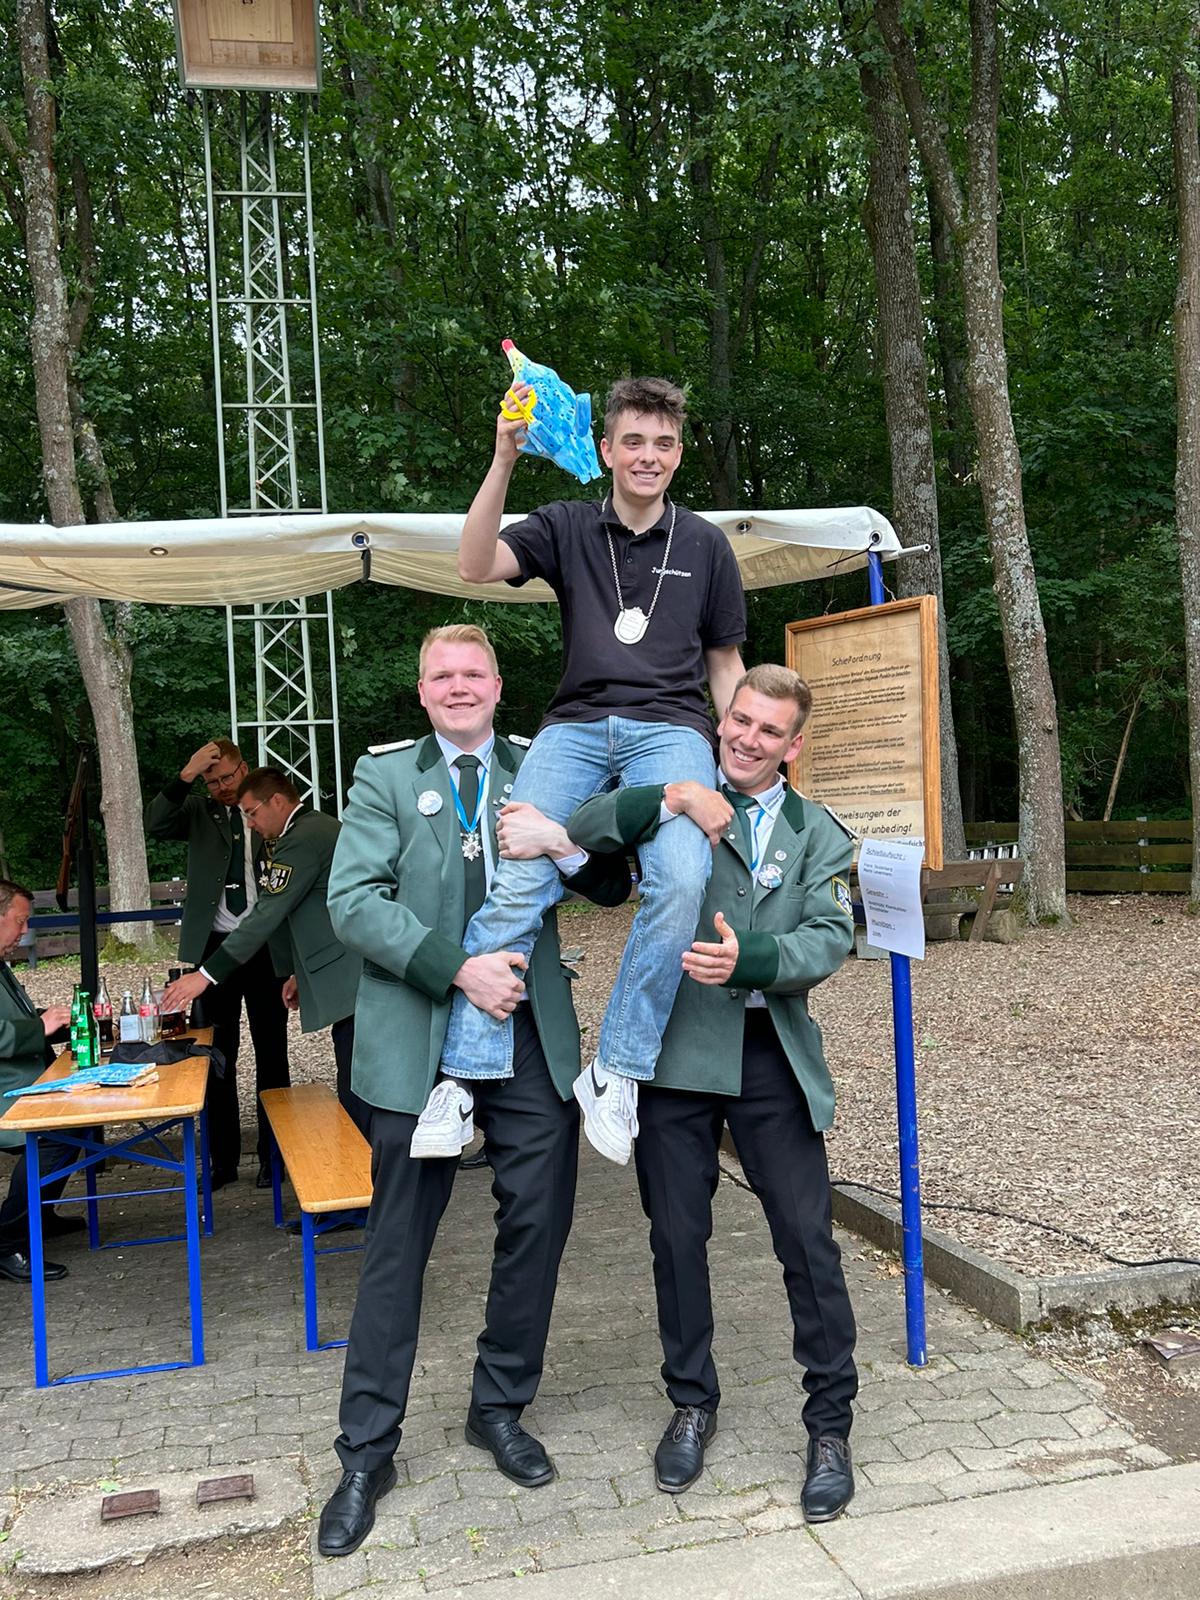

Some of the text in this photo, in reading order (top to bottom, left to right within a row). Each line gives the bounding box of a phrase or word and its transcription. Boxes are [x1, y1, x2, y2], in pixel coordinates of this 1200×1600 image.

[651, 566, 691, 577] Junschützen
[887, 808, 901, 817] der
[860, 825, 870, 835] ist
[871, 823, 912, 836] unbedingt
